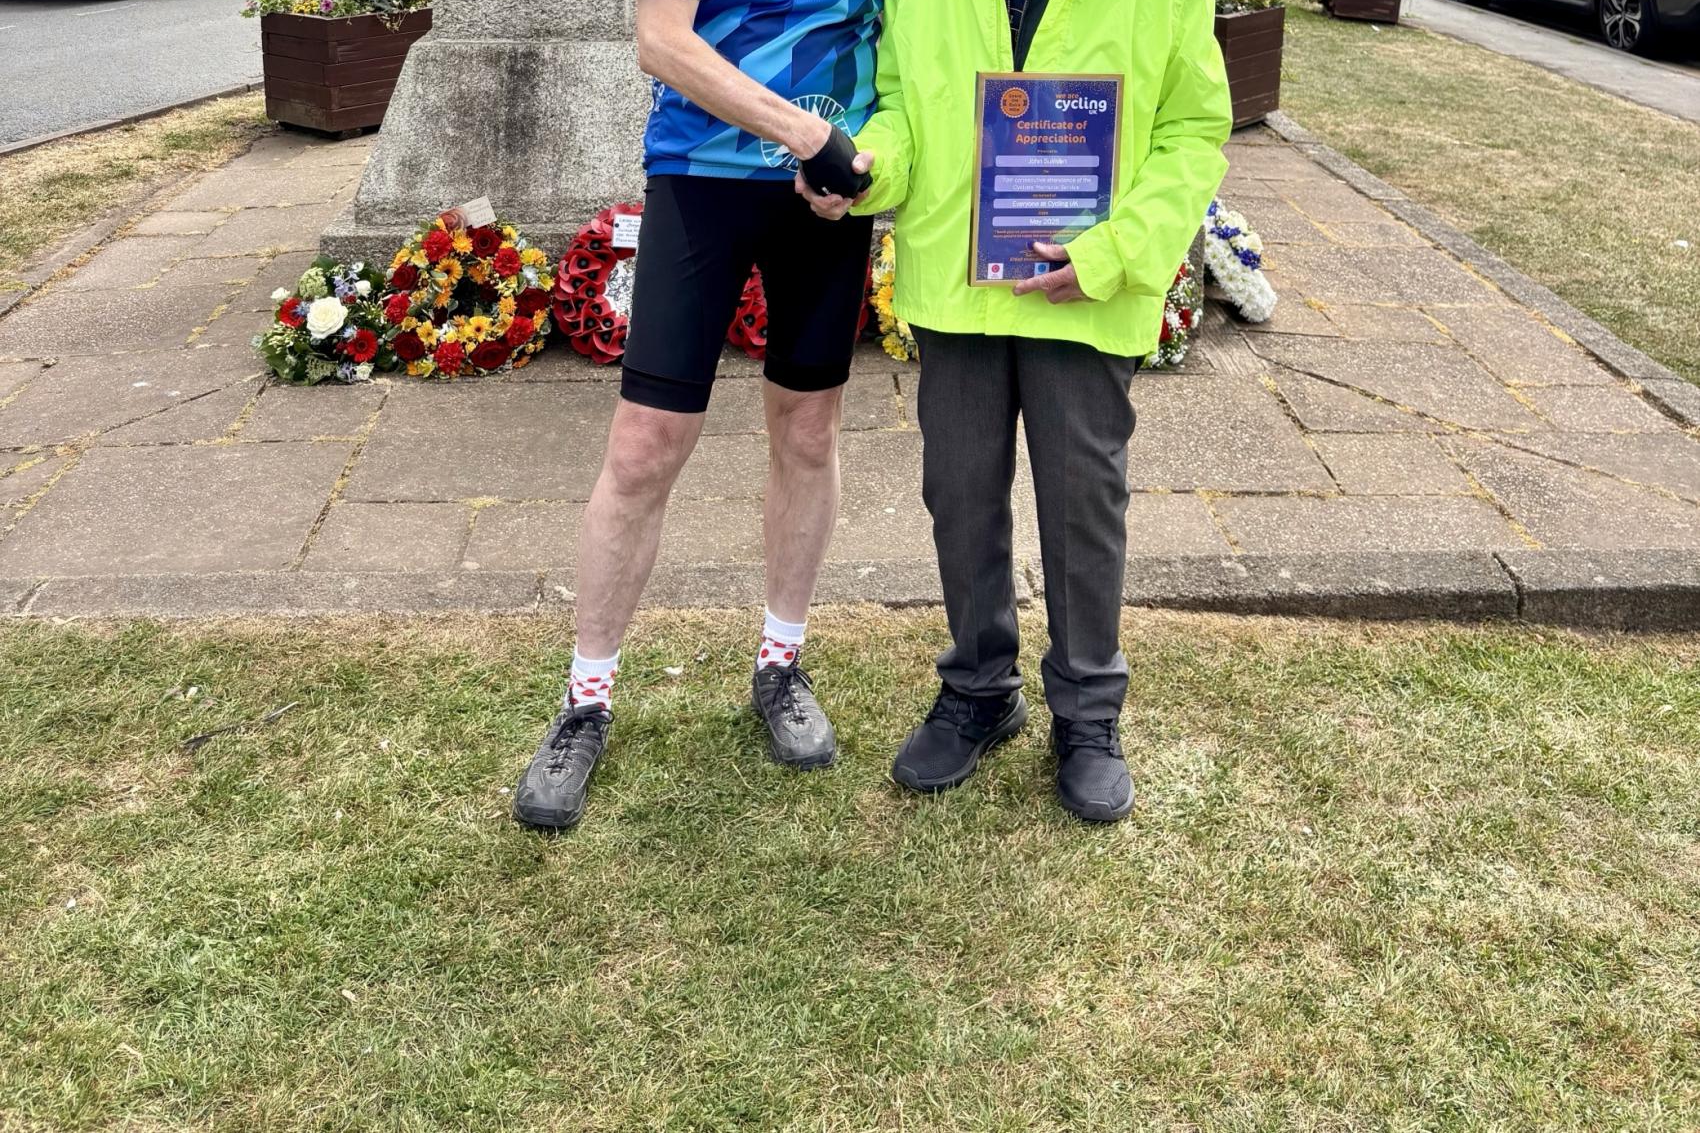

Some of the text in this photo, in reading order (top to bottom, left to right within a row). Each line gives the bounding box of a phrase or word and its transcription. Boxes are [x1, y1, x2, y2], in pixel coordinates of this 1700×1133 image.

[1054, 97, 1107, 113] cycling
[1017, 120, 1088, 130] Certificate of
[1015, 133, 1087, 145] Appreciation
